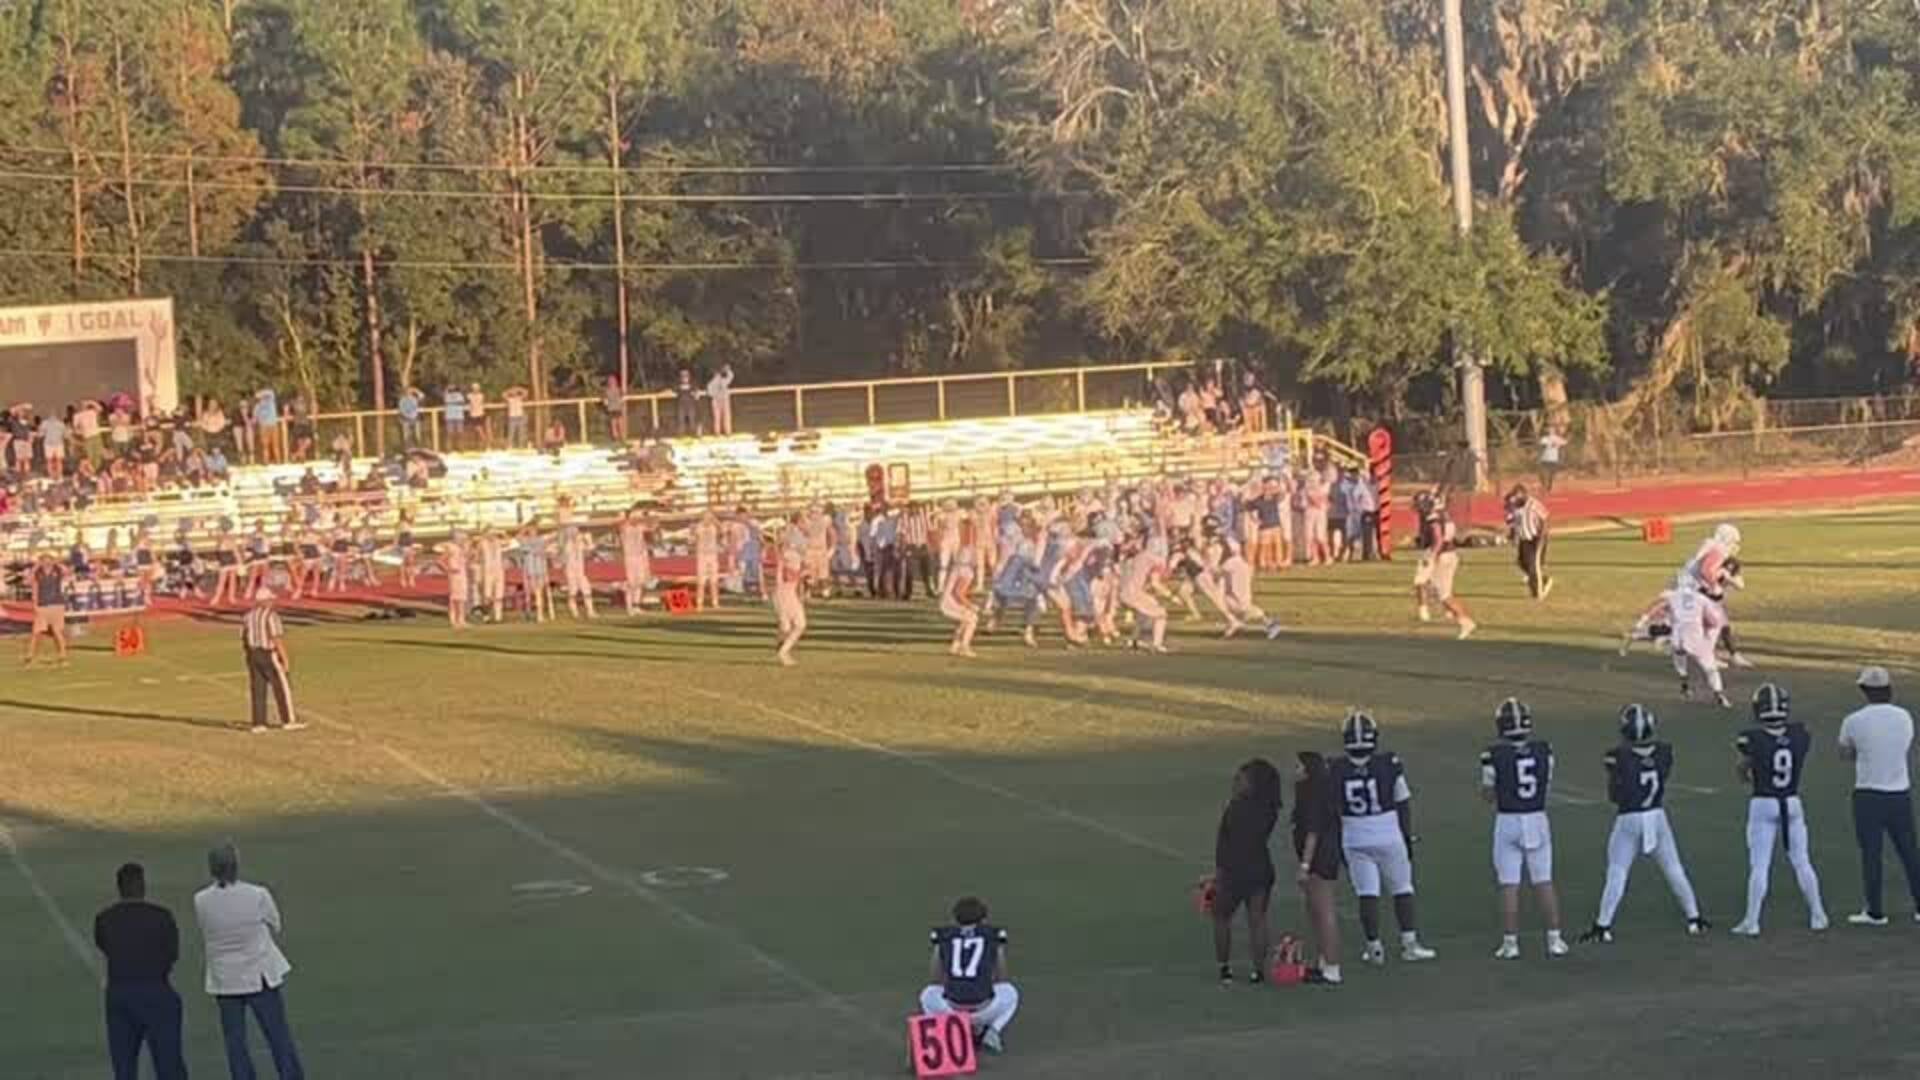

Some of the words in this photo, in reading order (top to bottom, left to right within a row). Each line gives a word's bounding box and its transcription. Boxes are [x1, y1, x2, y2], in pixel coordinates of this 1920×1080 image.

[79, 309, 144, 331] GOAL
[119, 629, 140, 650] 50
[1516, 758, 1537, 799] 5
[1773, 748, 1793, 788] 9
[1345, 779, 1382, 814] 51
[1639, 770, 1659, 808] 7
[951, 936, 986, 978] 17
[918, 1014, 968, 1071] 50
